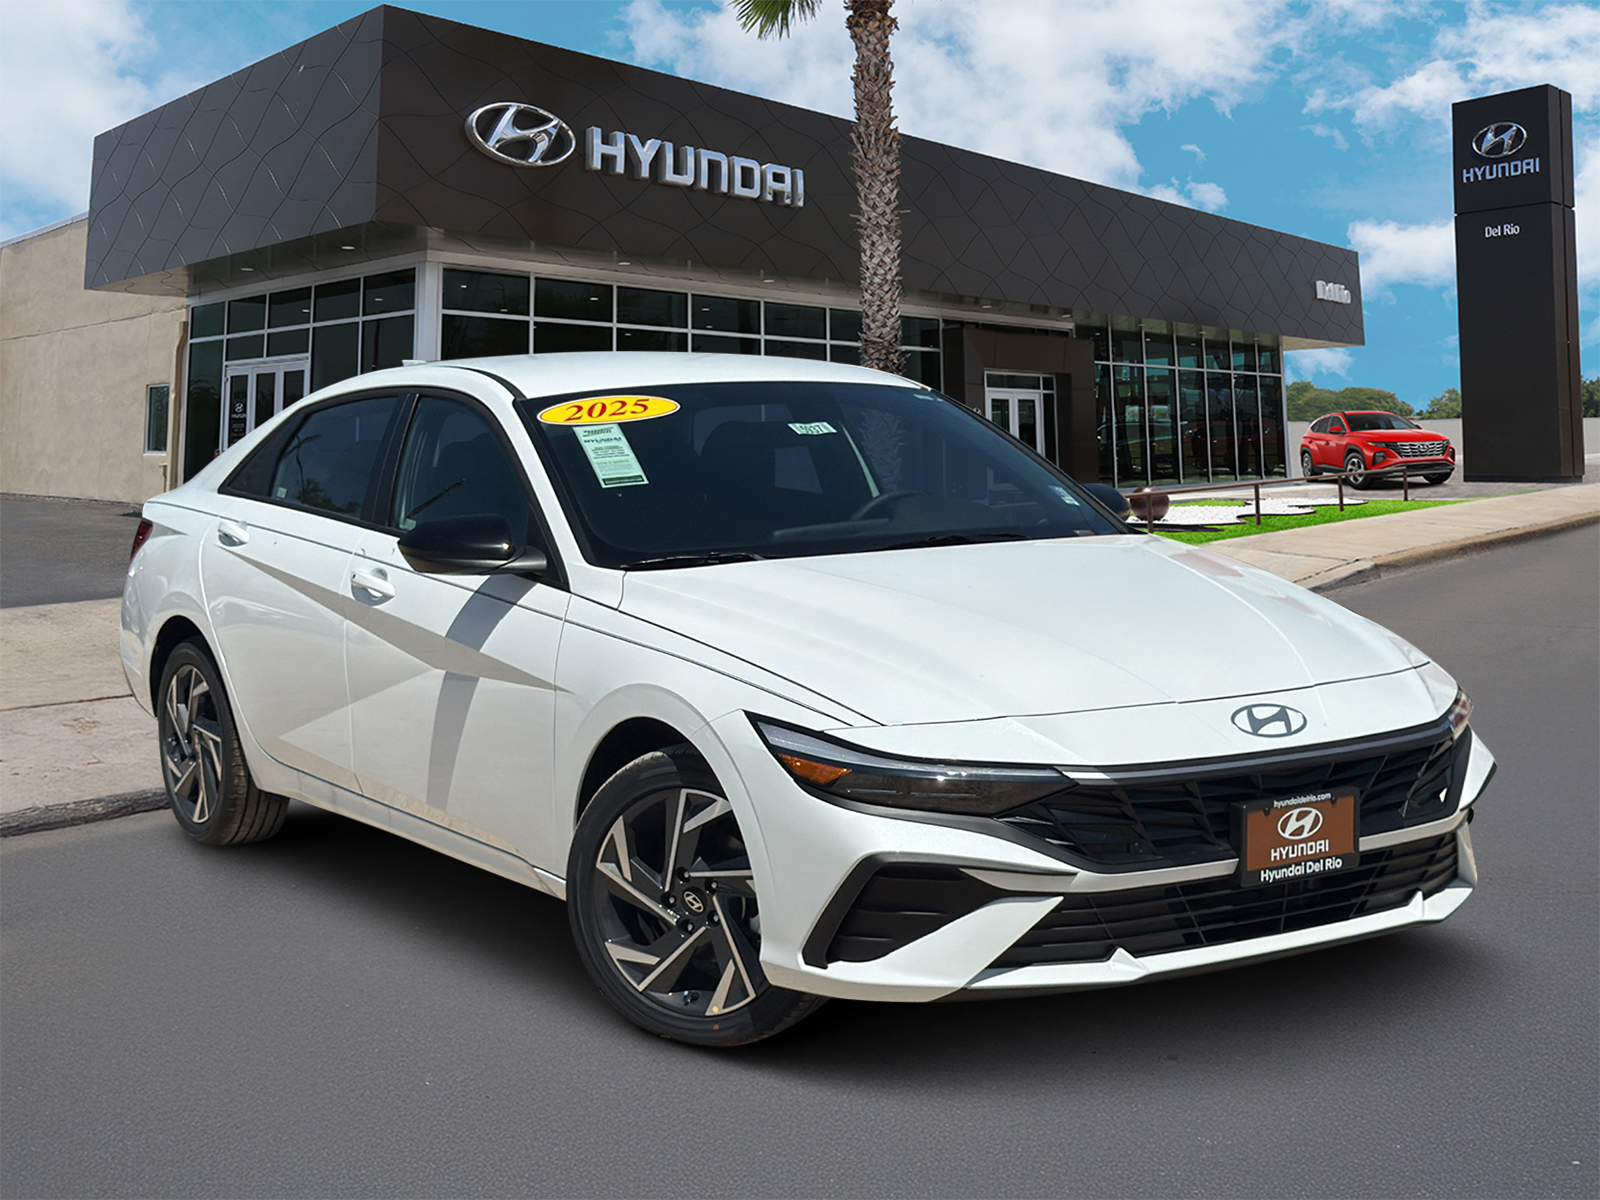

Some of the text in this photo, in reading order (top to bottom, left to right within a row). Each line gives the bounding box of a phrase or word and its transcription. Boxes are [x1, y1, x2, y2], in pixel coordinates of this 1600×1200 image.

[585, 125, 805, 208] HYUNDAI
[1462, 157, 1540, 183] HYUNDAI
[1484, 223, 1520, 238] Del Rio
[564, 398, 650, 422] 2025
[1270, 839, 1329, 862] HYUNDAI
[1260, 857, 1343, 883] Hyundai Del Rio
